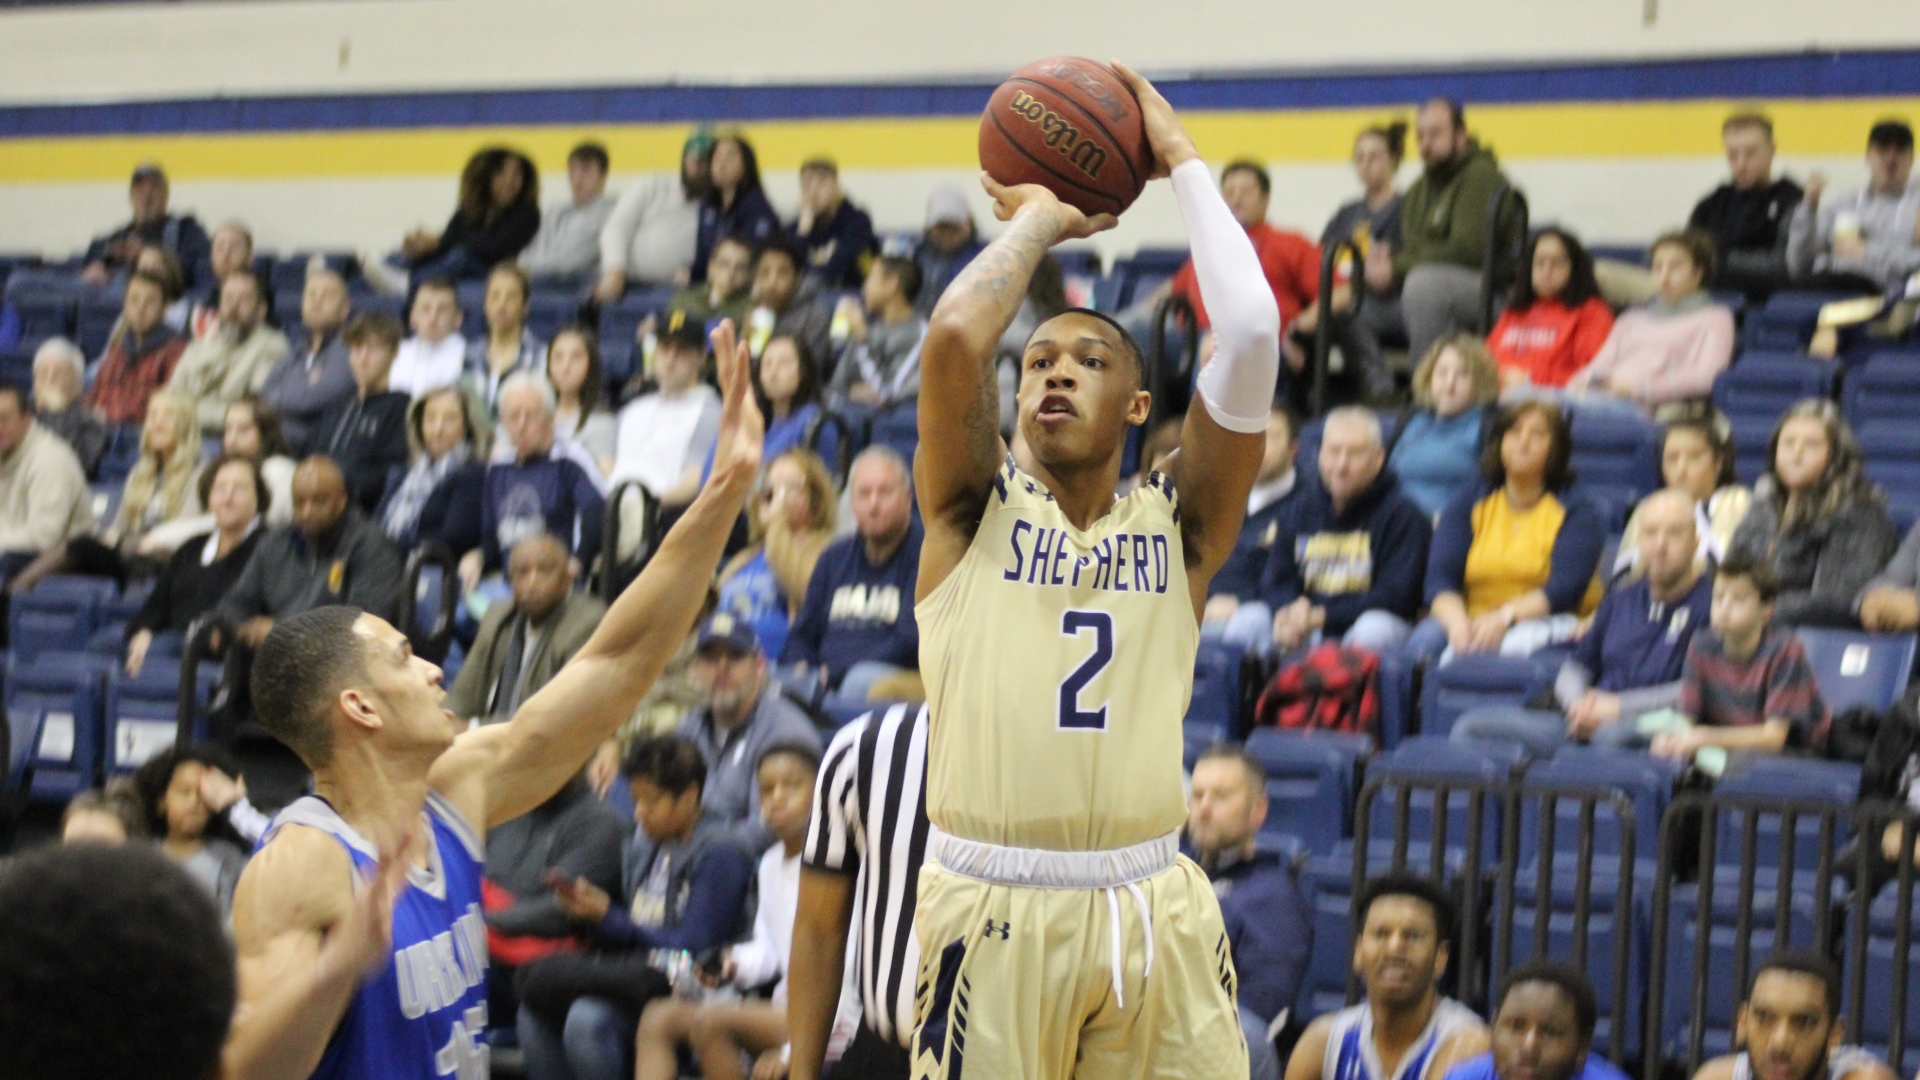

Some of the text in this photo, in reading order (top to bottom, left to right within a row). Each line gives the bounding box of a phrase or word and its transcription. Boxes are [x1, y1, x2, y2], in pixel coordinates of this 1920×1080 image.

[1009, 88, 1108, 182] Wilson
[1003, 518, 1169, 594] SHEPHERD
[1057, 608, 1114, 732] 2
